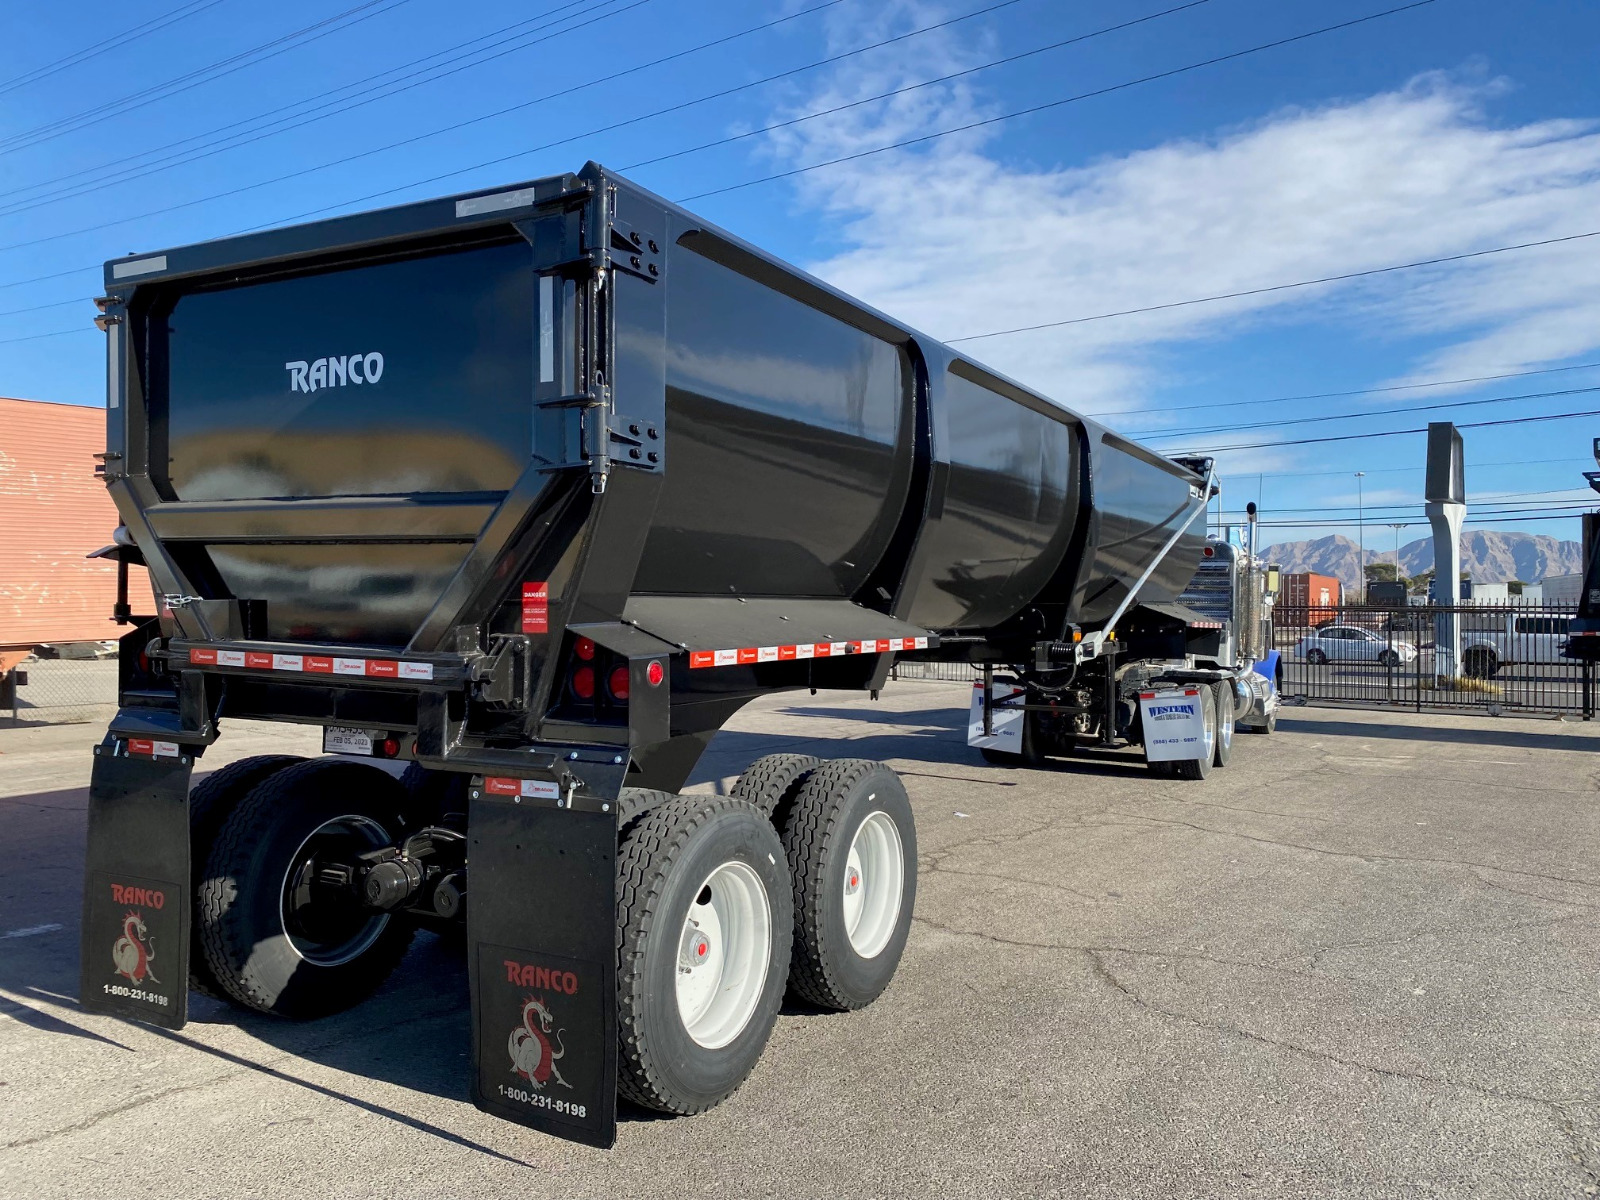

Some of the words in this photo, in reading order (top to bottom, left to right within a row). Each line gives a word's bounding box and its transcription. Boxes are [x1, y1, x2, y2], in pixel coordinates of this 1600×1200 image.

[286, 352, 384, 393] RANCO
[1148, 704, 1194, 717] WESTERN
[110, 883, 165, 909] RANCO
[503, 960, 578, 995] RANCO
[103, 984, 168, 1006] 1-800-231-8198
[498, 1084, 587, 1118] 1-800-231-8198
